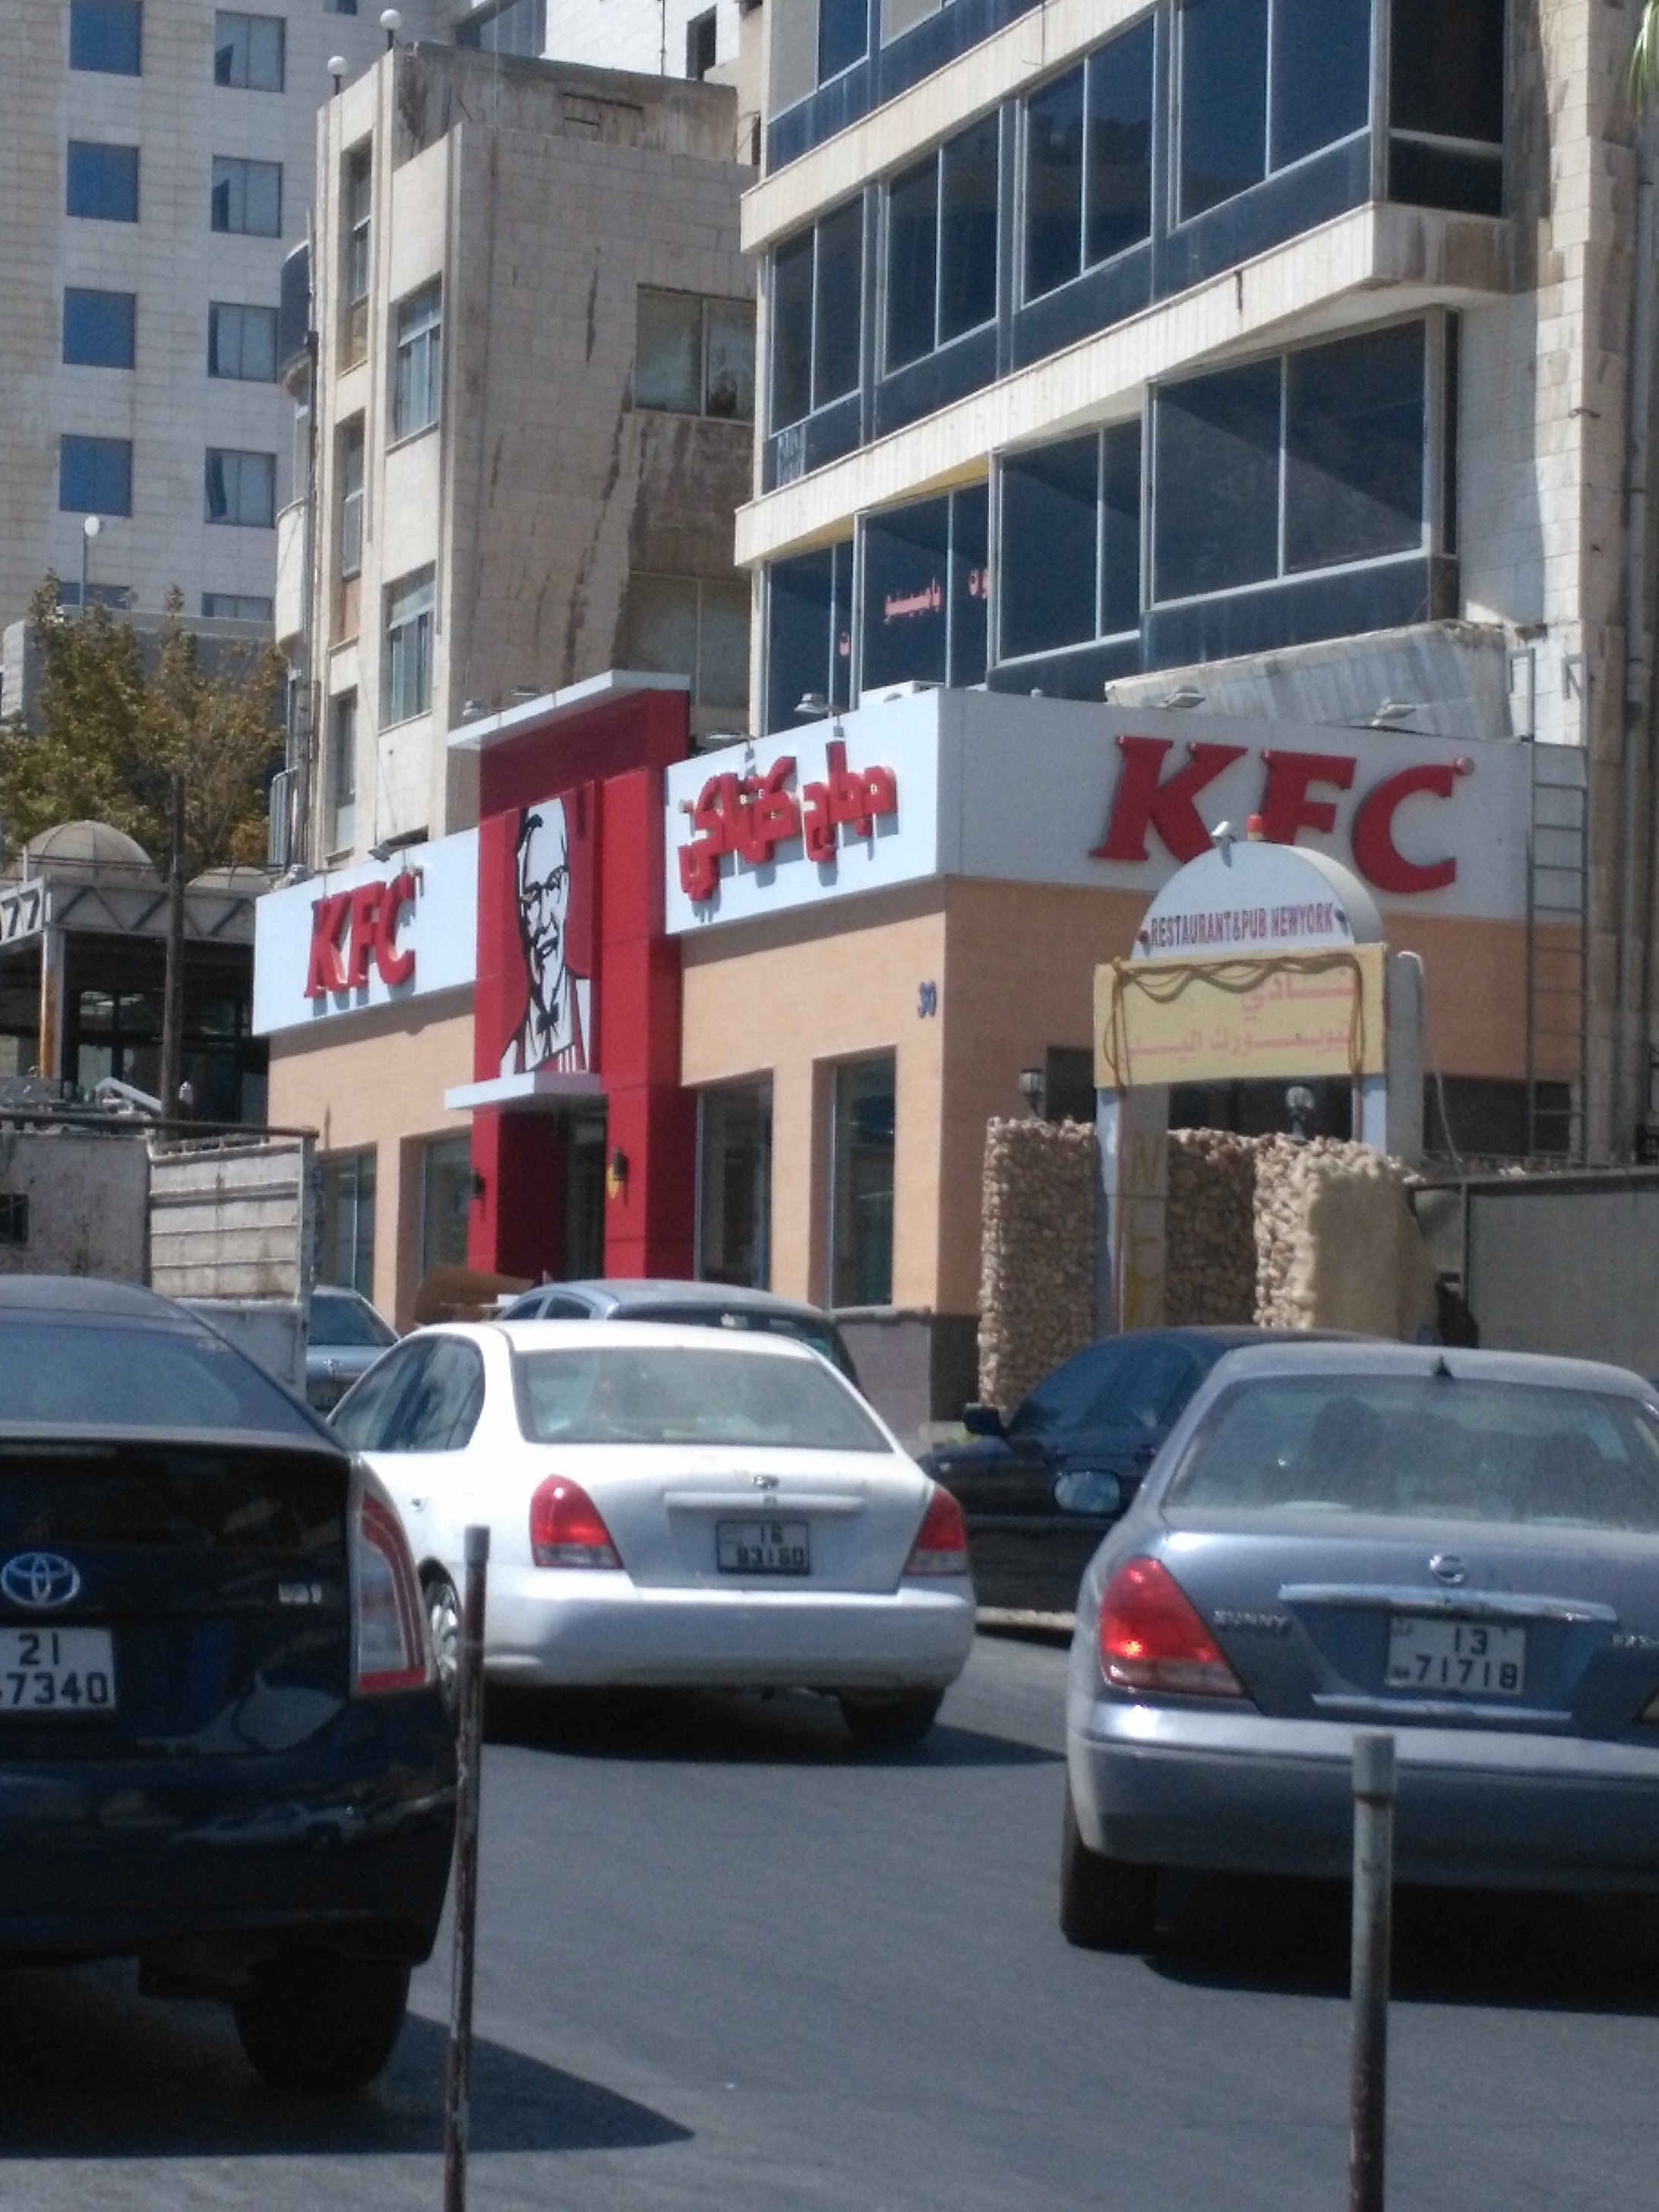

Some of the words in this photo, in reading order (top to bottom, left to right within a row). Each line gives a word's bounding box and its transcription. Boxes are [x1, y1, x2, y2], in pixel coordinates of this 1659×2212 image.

[1089, 734, 1457, 894] KFC
[0, 888, 41, 941] 77
[304, 871, 416, 999] KFC
[18, 1632, 59, 1666] 21
[1455, 1626, 1487, 1655] 13
[0, 1671, 108, 1704] 7340
[1416, 1653, 1518, 1690] 71718
